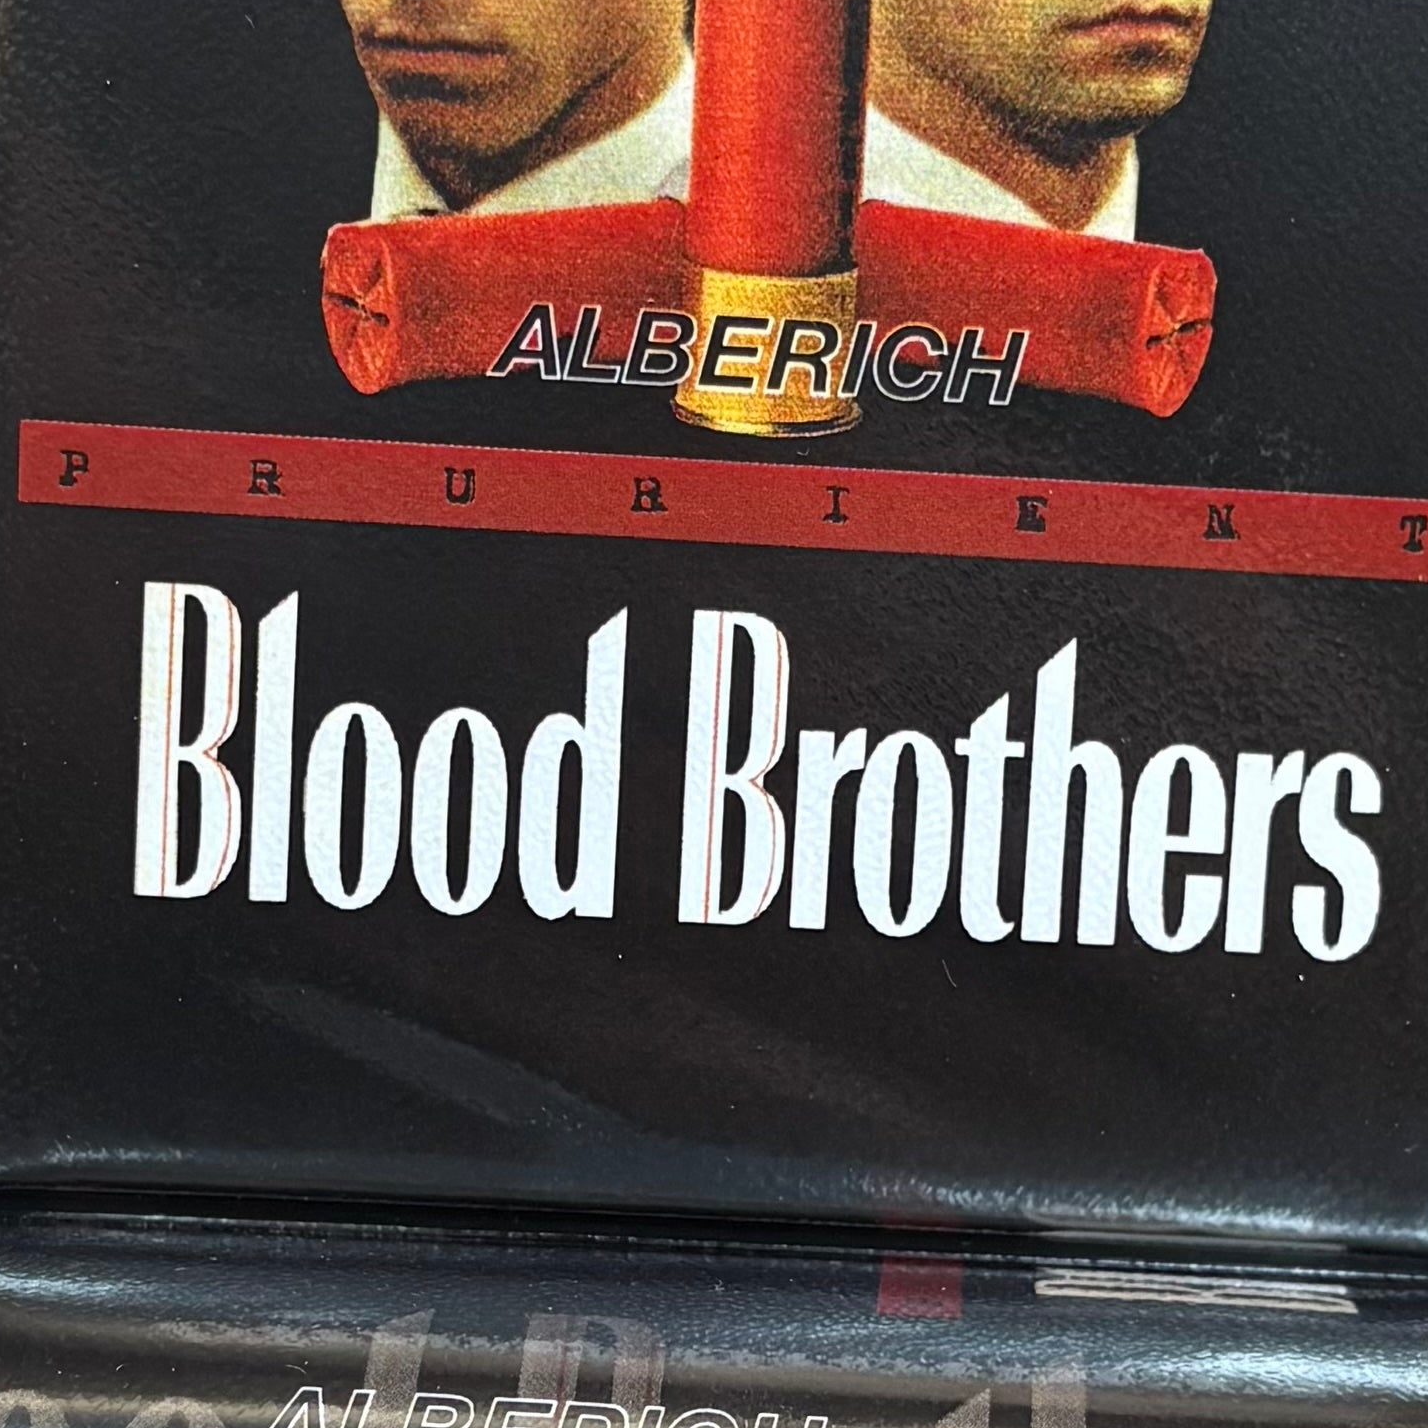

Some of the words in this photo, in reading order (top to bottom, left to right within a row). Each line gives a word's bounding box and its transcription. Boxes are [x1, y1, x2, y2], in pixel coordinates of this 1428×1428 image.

[487, 303, 1031, 408] ALBERICH
[134, 581, 629, 920] Blood
[678, 609, 1383, 963] Brothers
